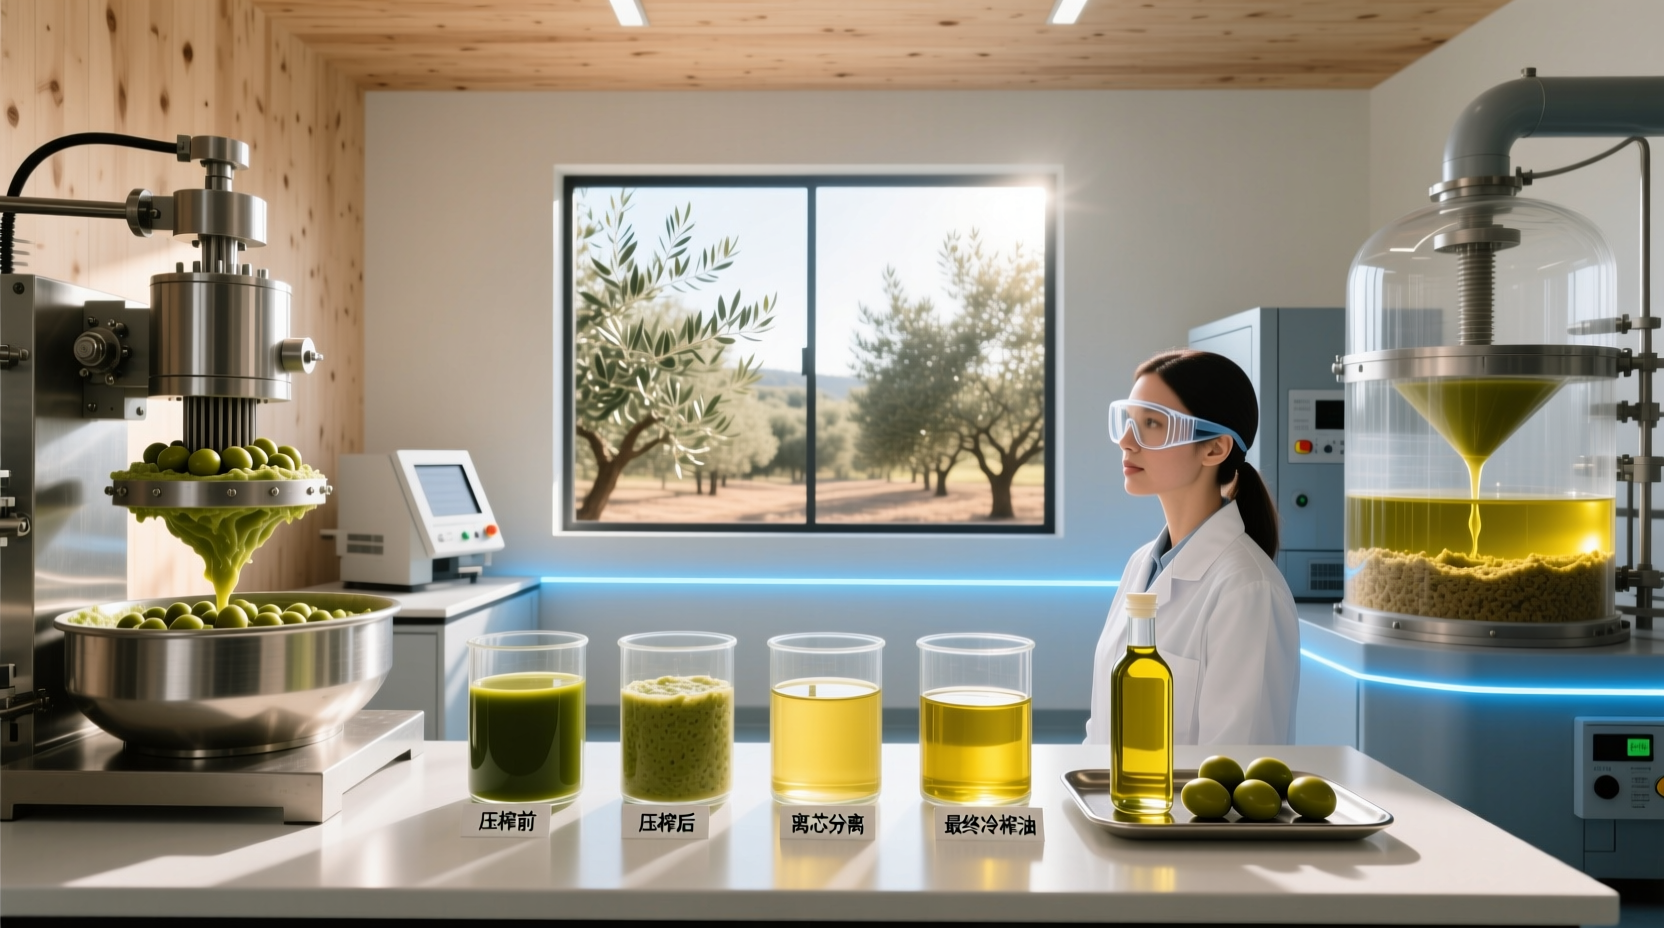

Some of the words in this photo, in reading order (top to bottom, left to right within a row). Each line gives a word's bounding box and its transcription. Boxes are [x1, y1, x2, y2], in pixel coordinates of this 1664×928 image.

[478, 810, 537, 832] 压榨前
[638, 811, 696, 833] 压榨后
[791, 812, 865, 836] 离芯分离
[944, 813, 1037, 836] 最终冷榨油
